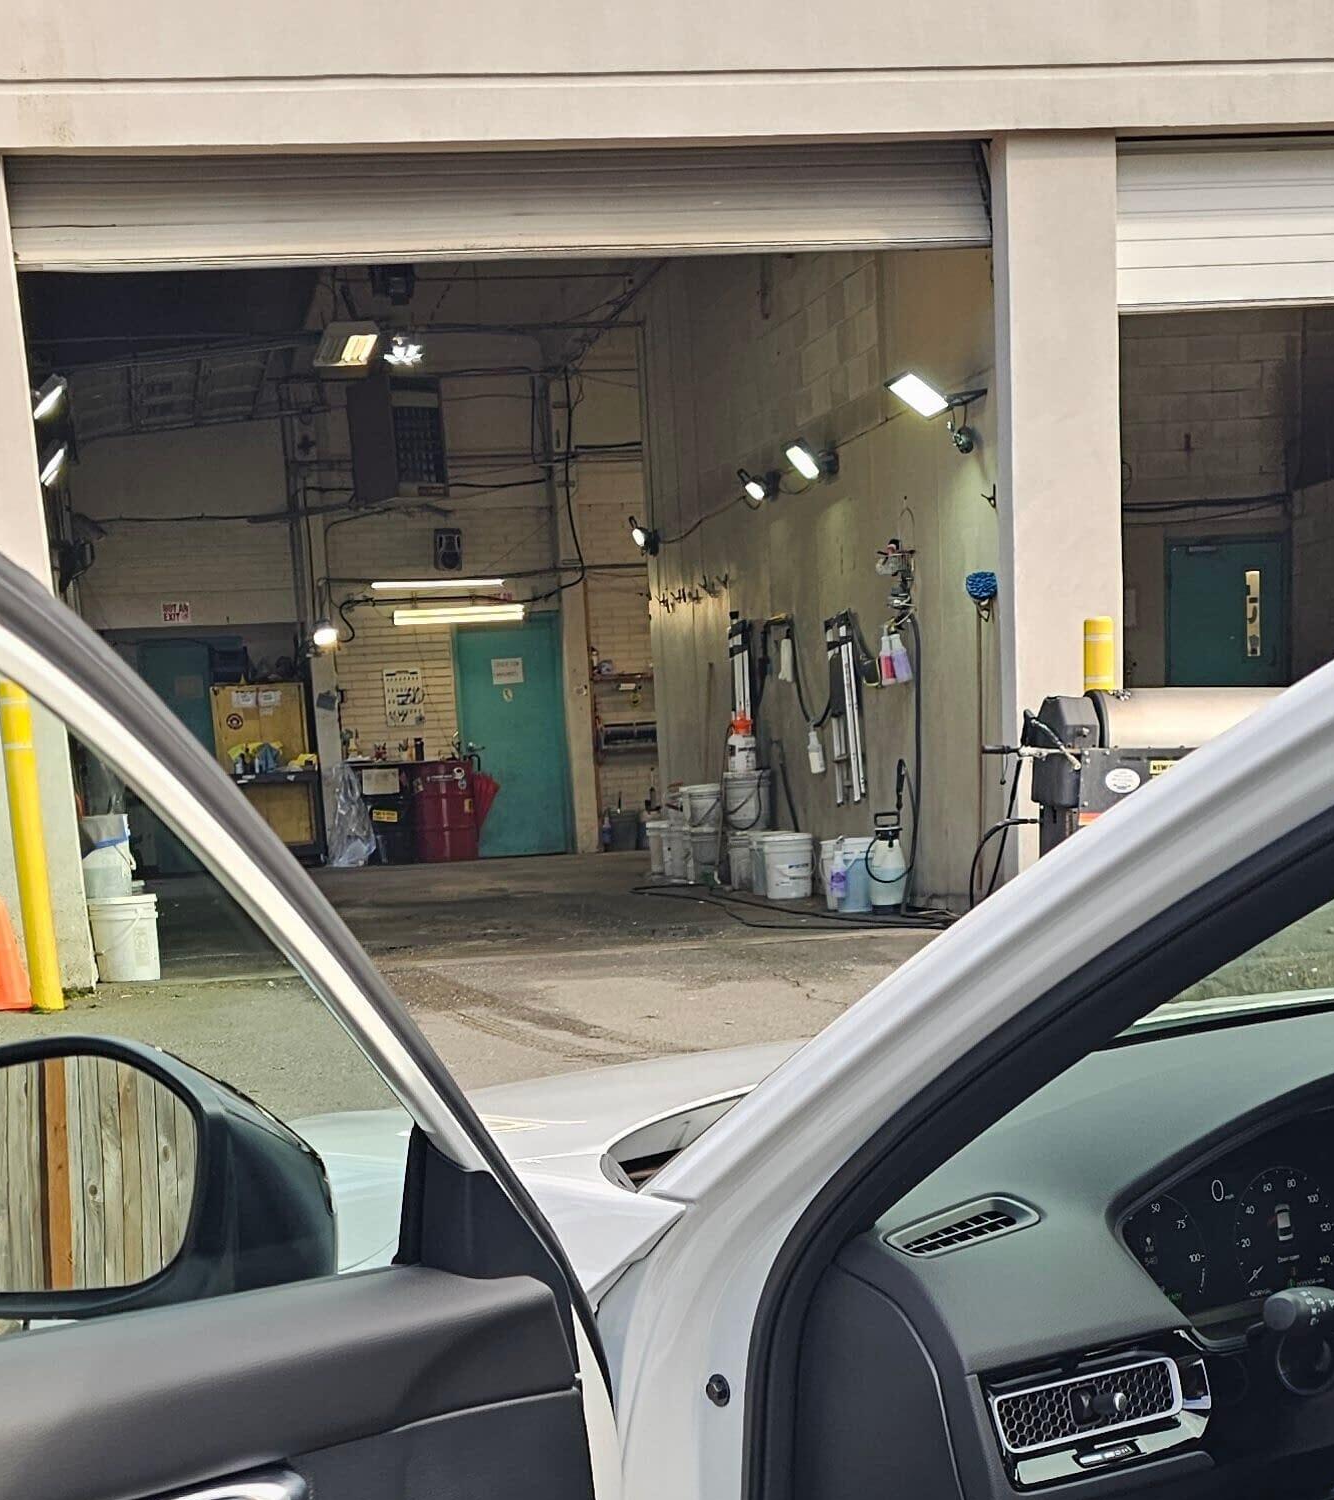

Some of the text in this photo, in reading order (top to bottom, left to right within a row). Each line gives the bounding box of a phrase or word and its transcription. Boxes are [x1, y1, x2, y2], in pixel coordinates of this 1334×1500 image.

[164, 613, 179, 621] EXIT
[1263, 1183, 1272, 1192] 60
[1287, 1179, 1296, 1188] 80
[1211, 1179, 1224, 1201] 0
[1307, 1194, 1319, 1203] 100
[1152, 1203, 1161, 1213] 50
[1246, 1205, 1255, 1214] 40
[1176, 1219, 1186, 1229] 75
[1320, 1223, 1332, 1231] 120
[1241, 1238, 1251, 1248] 20
[1189, 1253, 1200, 1262] 100
[1319, 1256, 1330, 1264] 140
